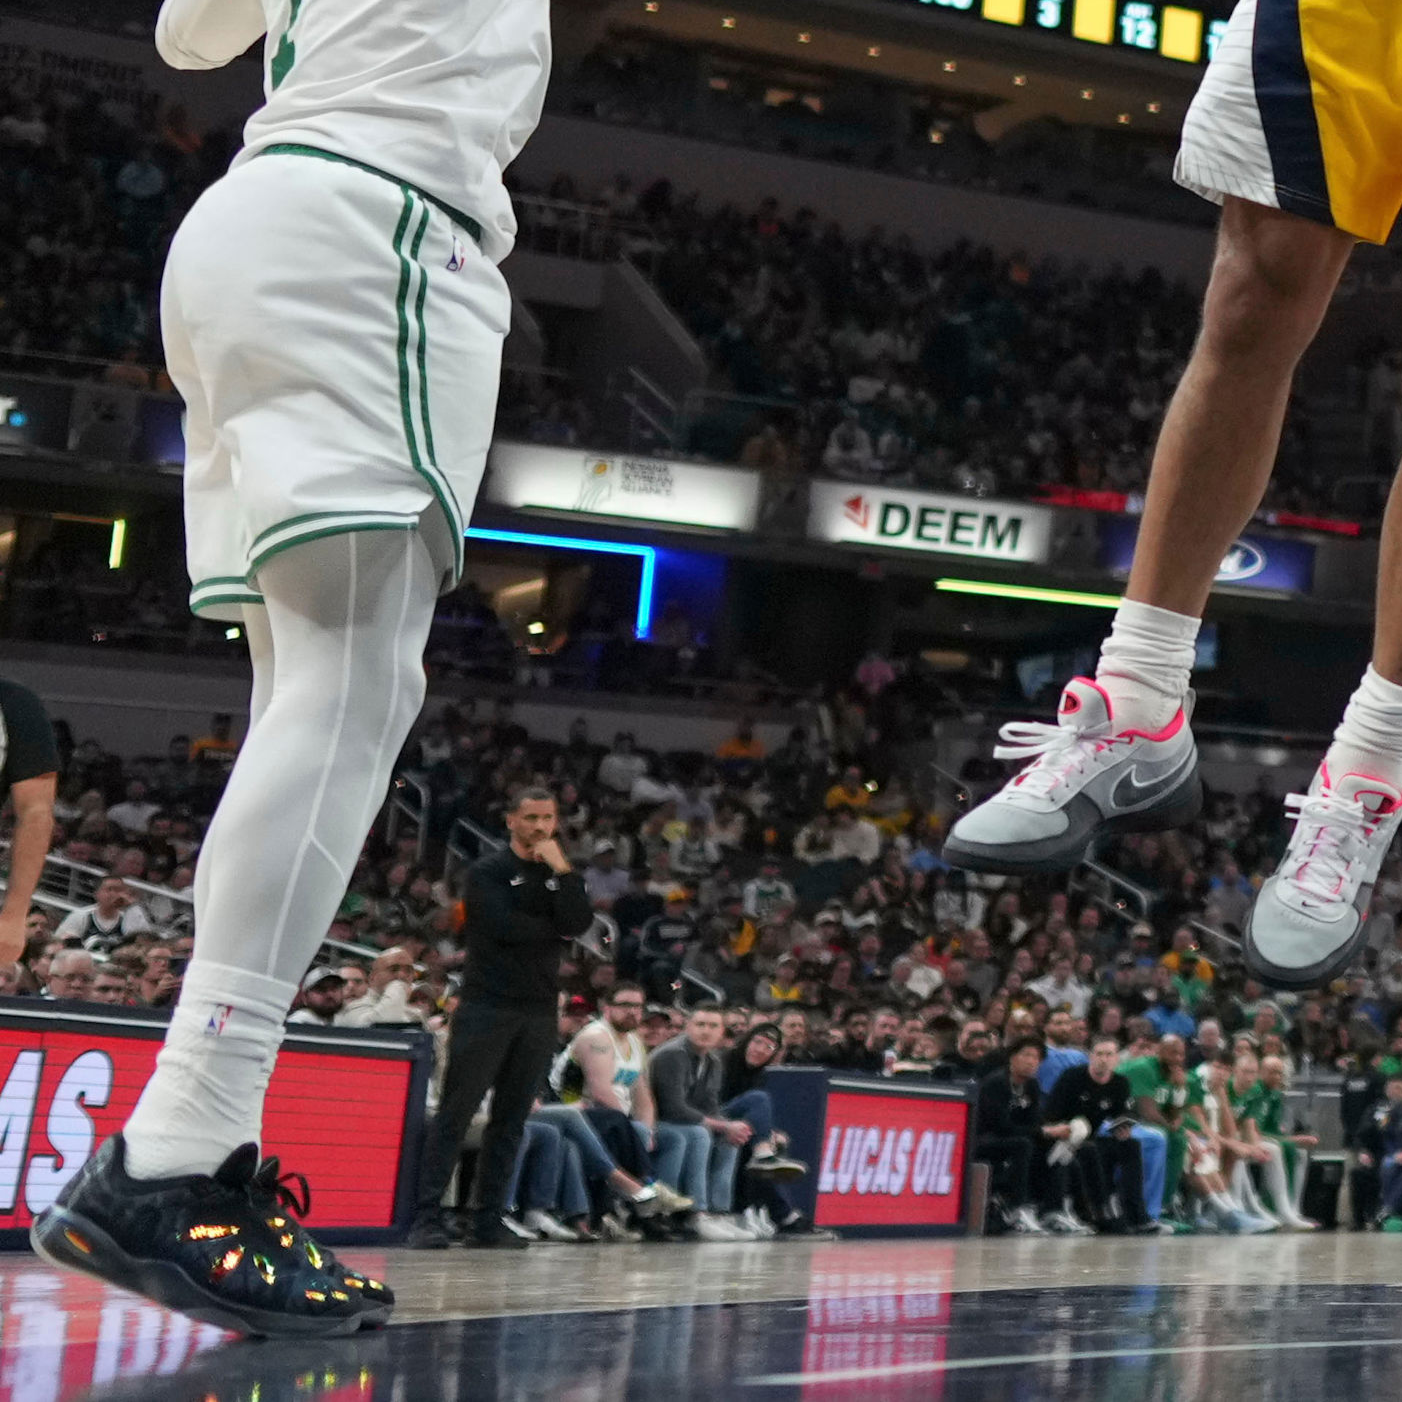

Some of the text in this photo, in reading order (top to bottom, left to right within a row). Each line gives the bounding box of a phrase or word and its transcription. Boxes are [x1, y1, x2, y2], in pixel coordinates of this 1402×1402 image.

[1121, 16, 1158, 50] 12
[877, 501, 1024, 552] DEEM
[817, 1125, 956, 1196] LUCAS OIL
